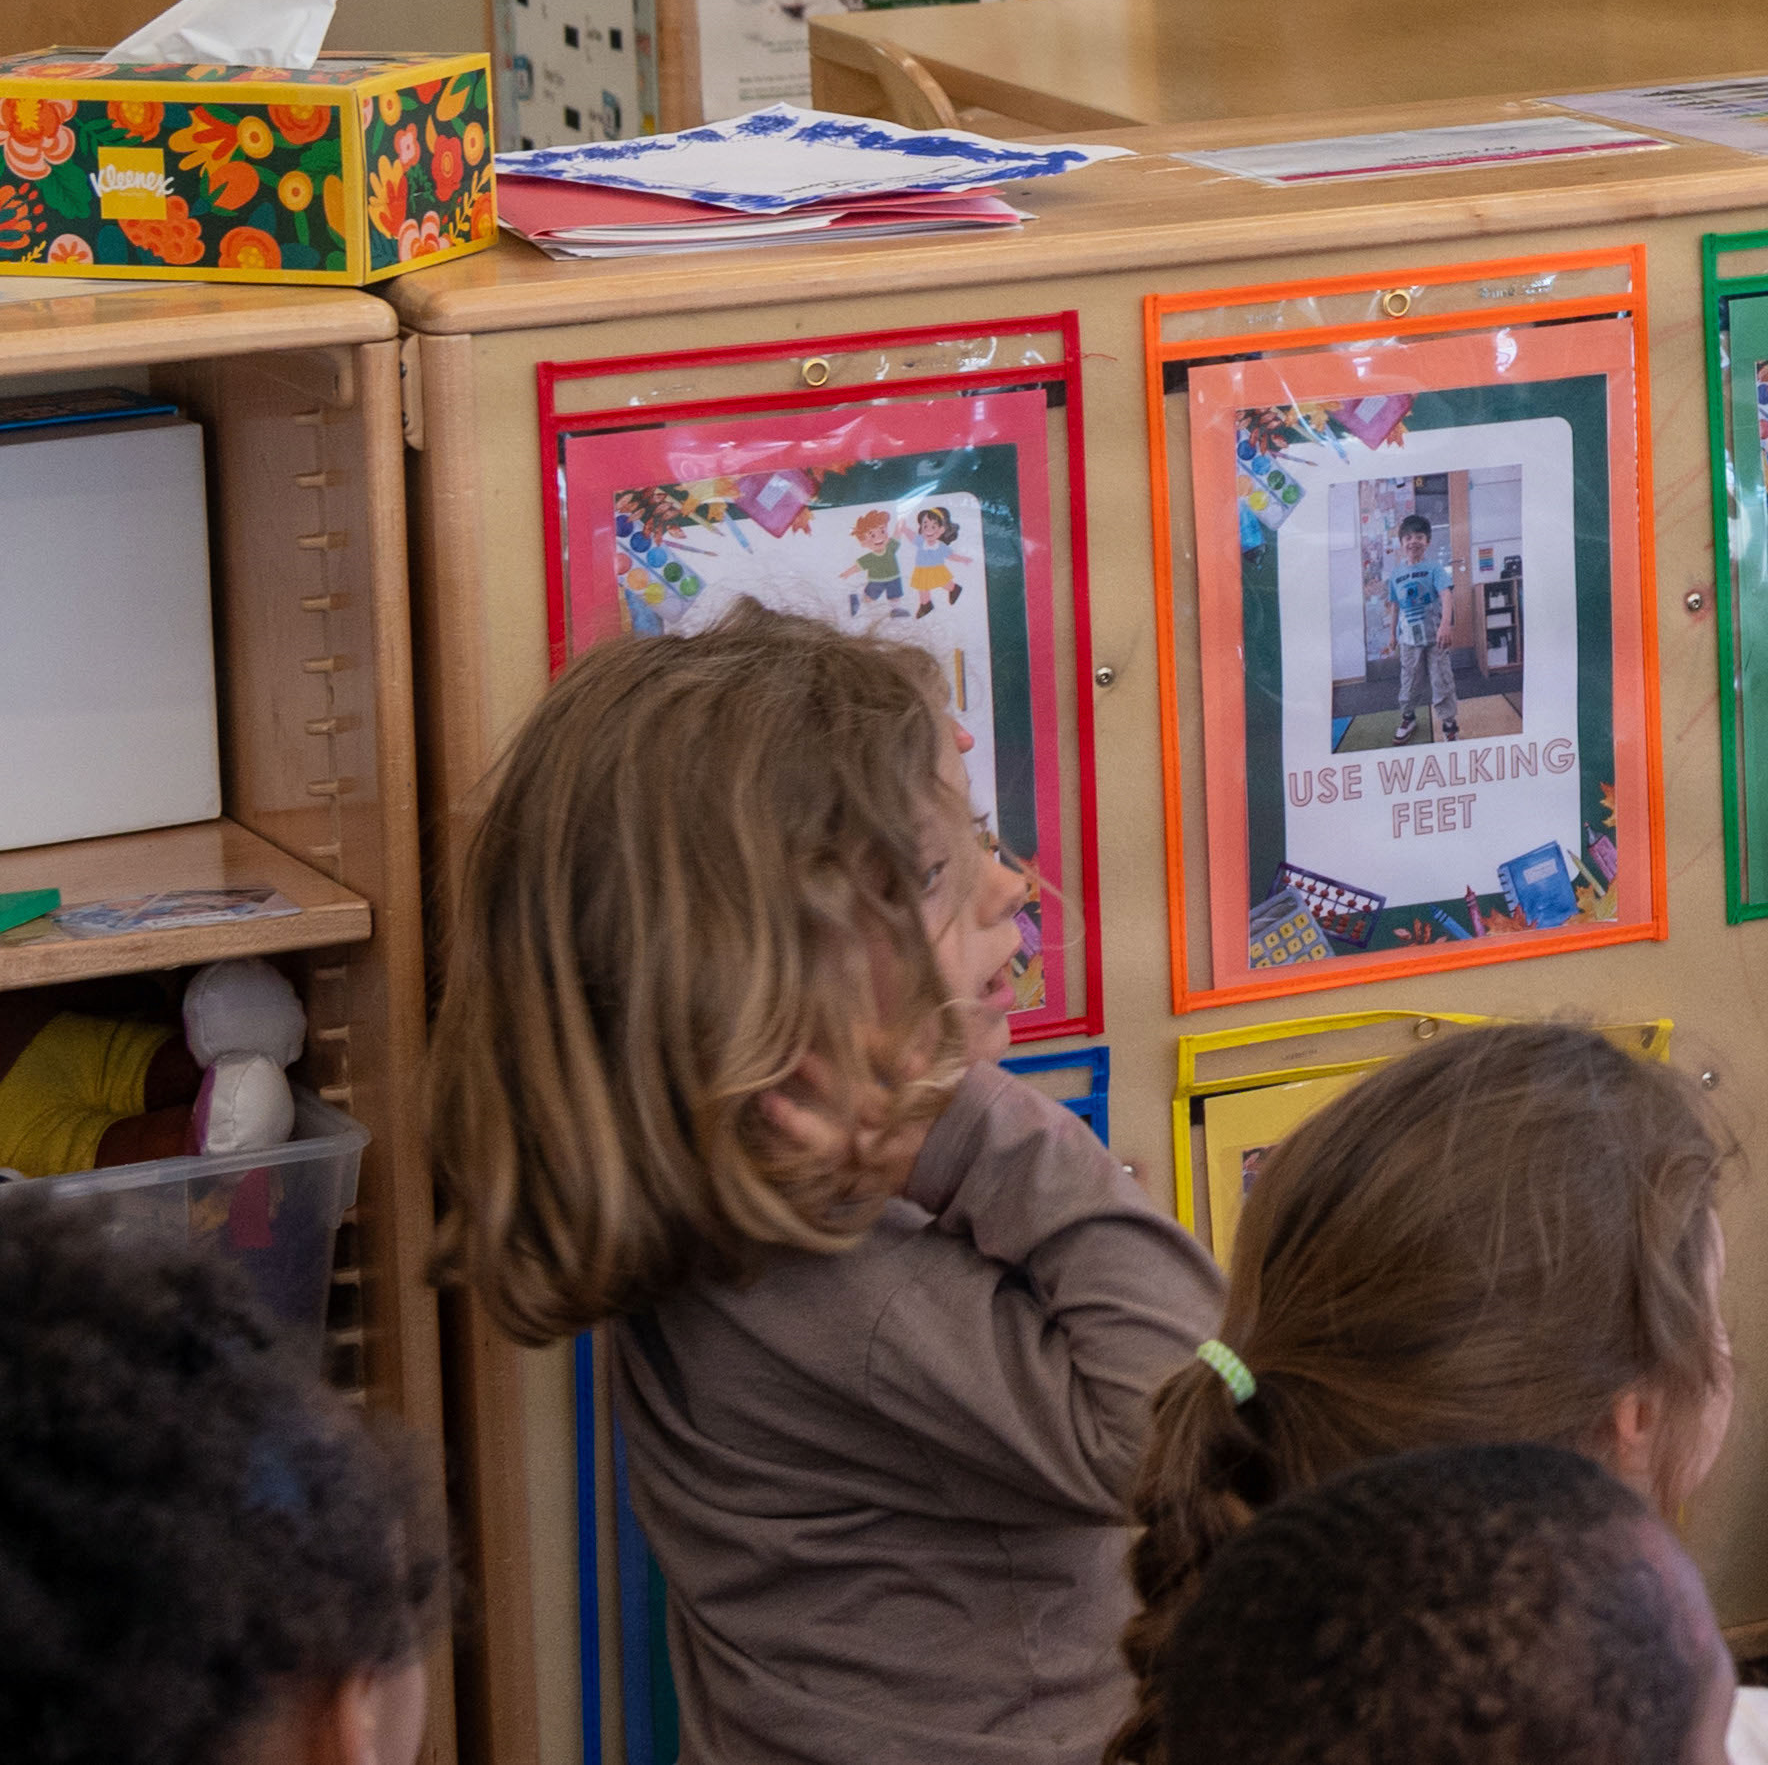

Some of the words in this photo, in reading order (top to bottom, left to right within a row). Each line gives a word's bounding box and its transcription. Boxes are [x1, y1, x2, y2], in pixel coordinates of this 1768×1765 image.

[89, 163, 175, 198] Kleenex
[1289, 767, 1364, 808] USE
[1377, 737, 1577, 797] WALKING
[1392, 792, 1479, 839] FEET
